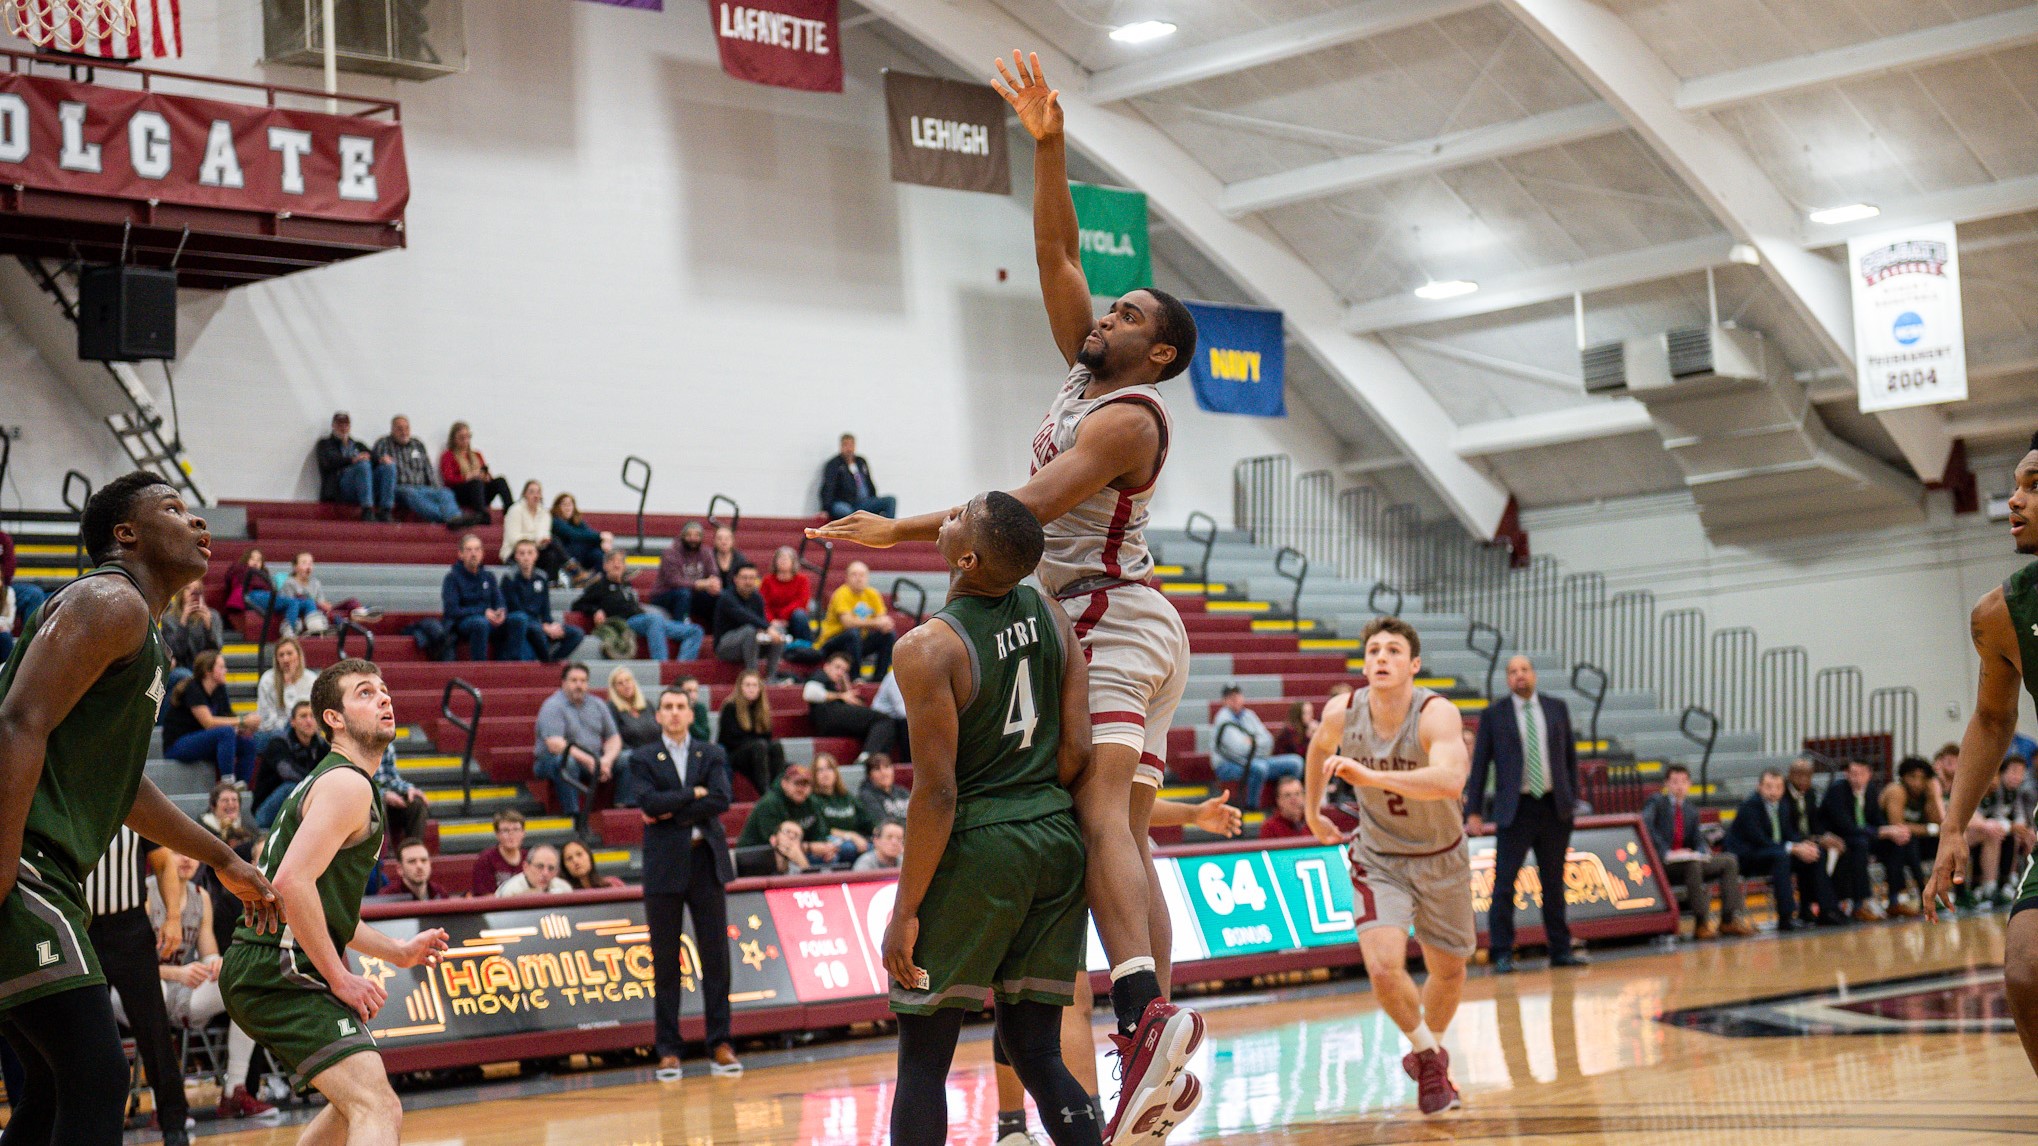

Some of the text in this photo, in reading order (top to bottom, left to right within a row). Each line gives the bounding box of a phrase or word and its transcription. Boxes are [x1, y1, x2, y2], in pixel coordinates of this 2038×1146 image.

[720, 3, 830, 54] LAFAYETTE
[911, 116, 989, 156] LEHIGH
[1209, 347, 1262, 383] NAVY
[1887, 369, 1938, 391] 2004
[1003, 655, 1039, 750] 4
[1383, 789, 1408, 816] 2
[1198, 859, 1267, 916] 64
[1295, 858, 1355, 934] L
[806, 909, 828, 935] 2
[1221, 924, 1273, 948] BONUS
[36, 940, 59, 966] L
[799, 938, 848, 958] FOULS
[814, 960, 849, 989] 10
[337, 1018, 357, 1037] L
